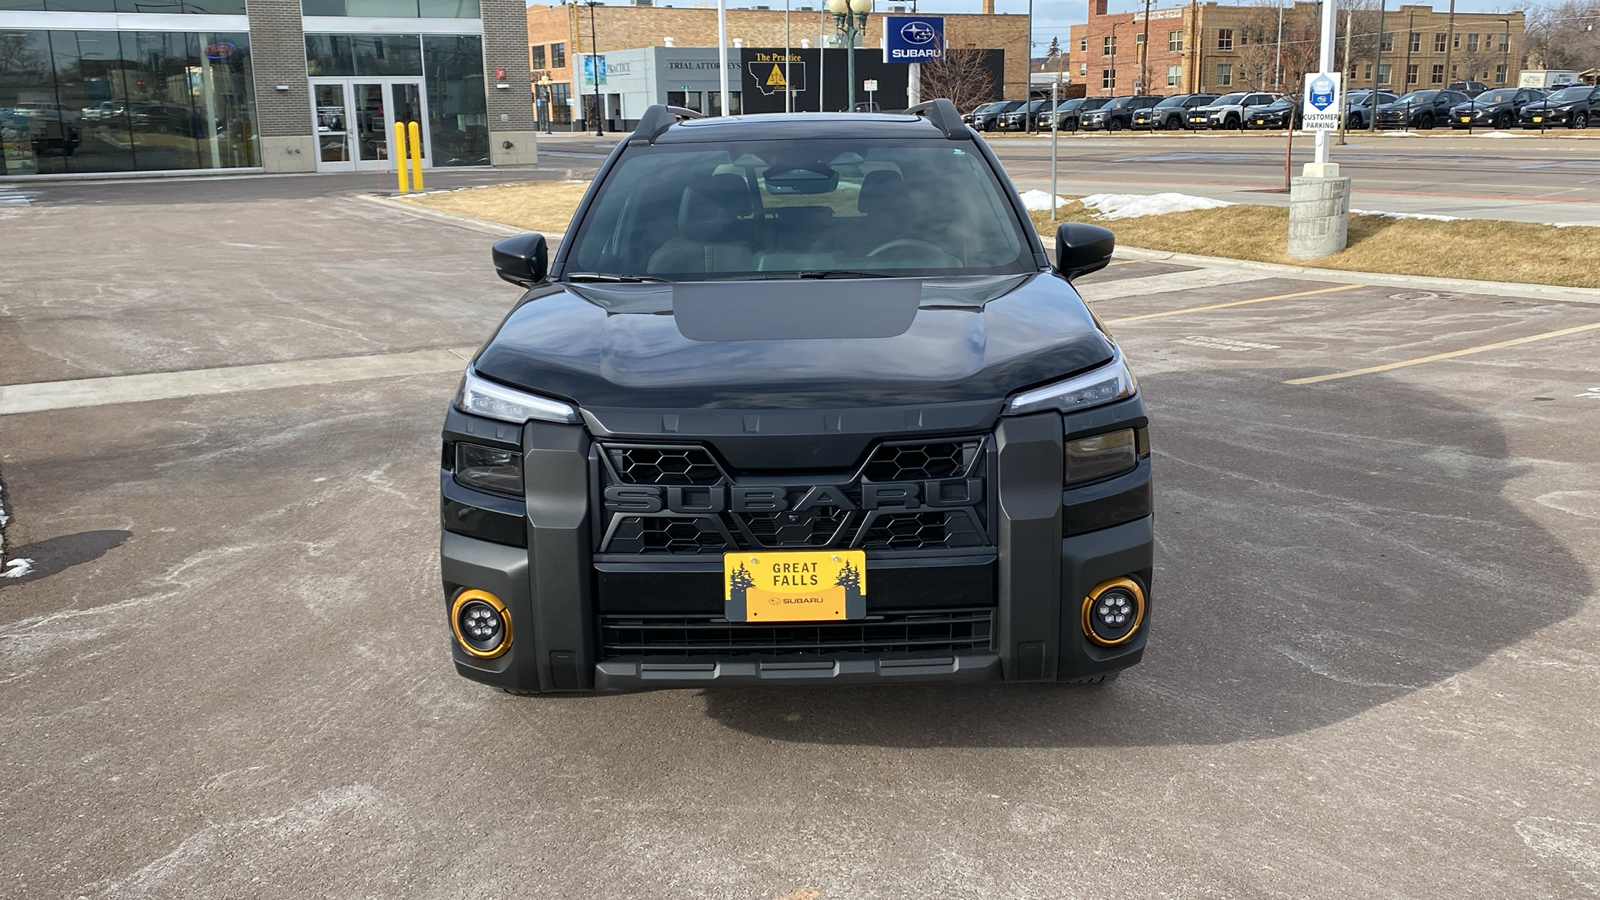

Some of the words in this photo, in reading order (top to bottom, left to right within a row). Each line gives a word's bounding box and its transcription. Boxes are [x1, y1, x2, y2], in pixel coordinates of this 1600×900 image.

[204, 44, 234, 57] OPEN
[892, 49, 941, 58] SUBARU
[755, 53, 770, 62] The
[772, 53, 802, 62] Pratice
[606, 63, 631, 74] PRACTICE
[669, 62, 695, 70] TRIAL
[695, 62, 742, 70] ATTOREYS
[1303, 113, 1339, 121] CUSTOMER
[603, 477, 984, 513] SUBARU
[772, 562, 818, 573] GREAT
[773, 574, 818, 586] FALLS
